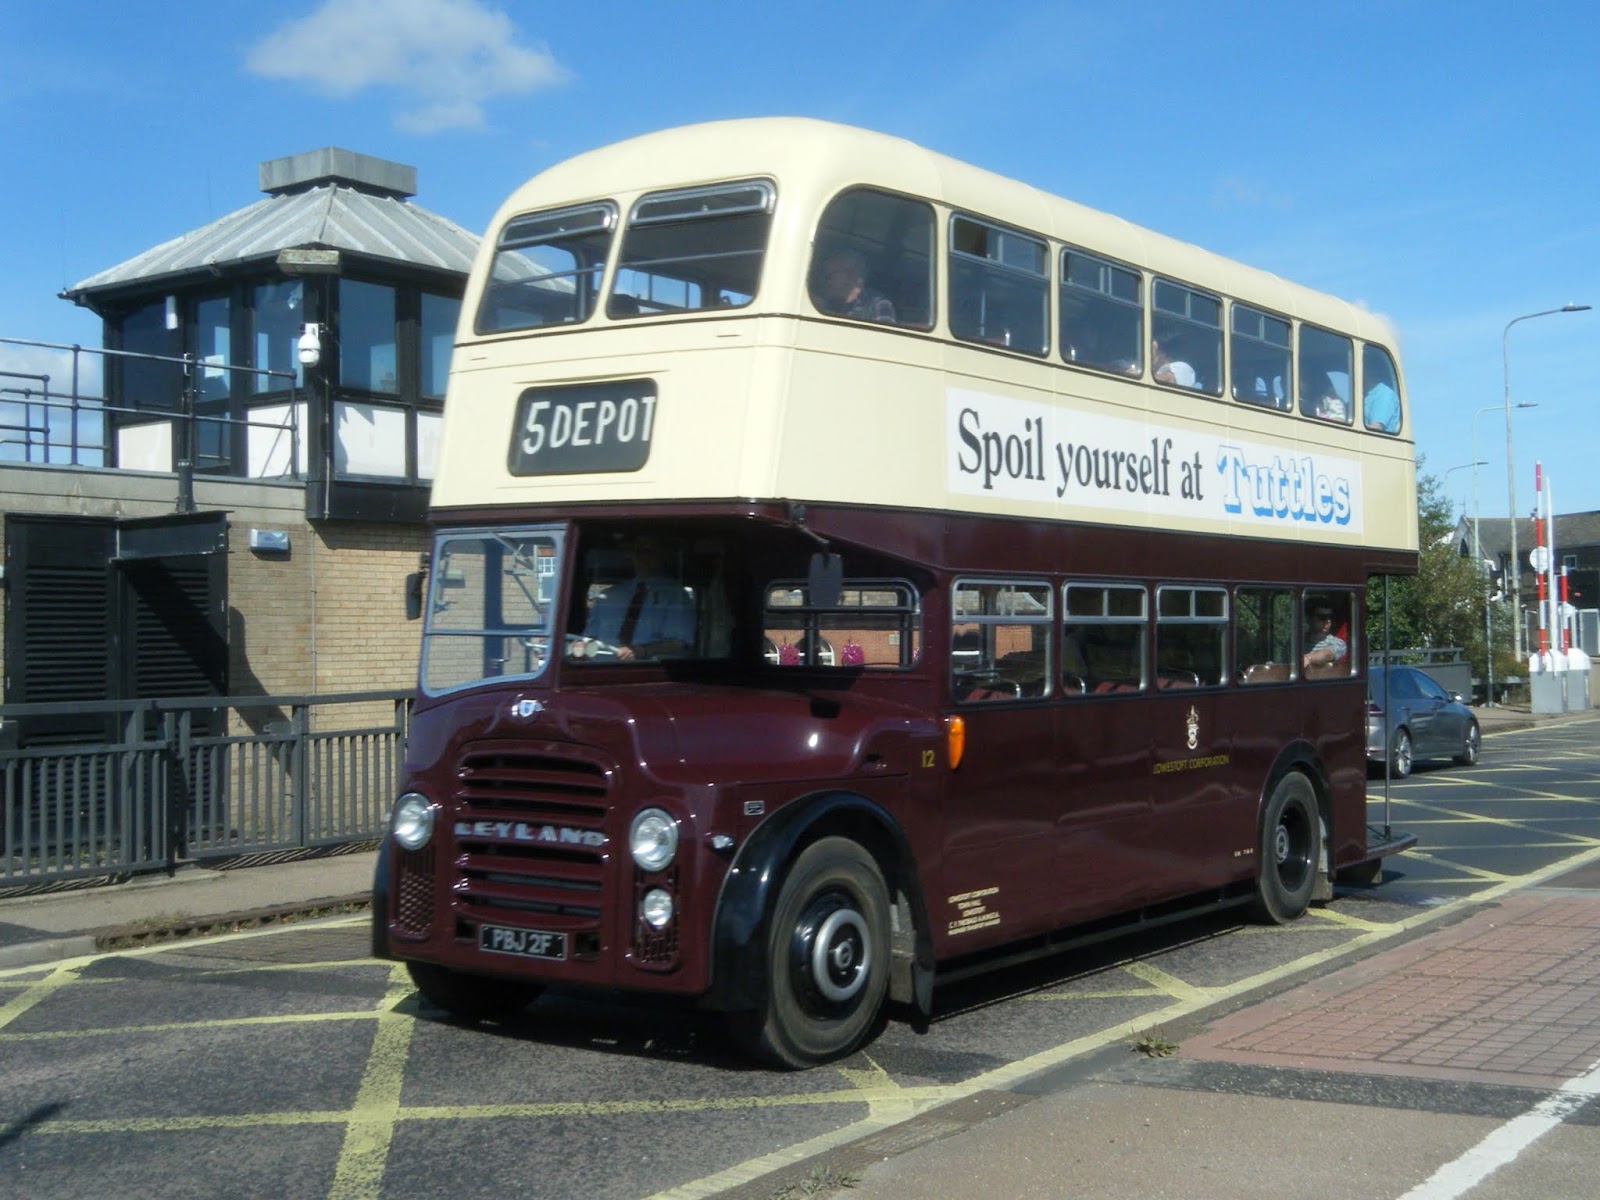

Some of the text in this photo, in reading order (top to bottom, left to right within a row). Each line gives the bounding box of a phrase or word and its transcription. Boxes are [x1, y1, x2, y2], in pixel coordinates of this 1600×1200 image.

[522, 396, 656, 454] 5 DEPOT
[958, 407, 1351, 526] Spoil yourself at Tuttles
[922, 750, 935, 768] 12
[454, 821, 605, 847] LEYLAND
[492, 929, 553, 954] PBJ 2F
